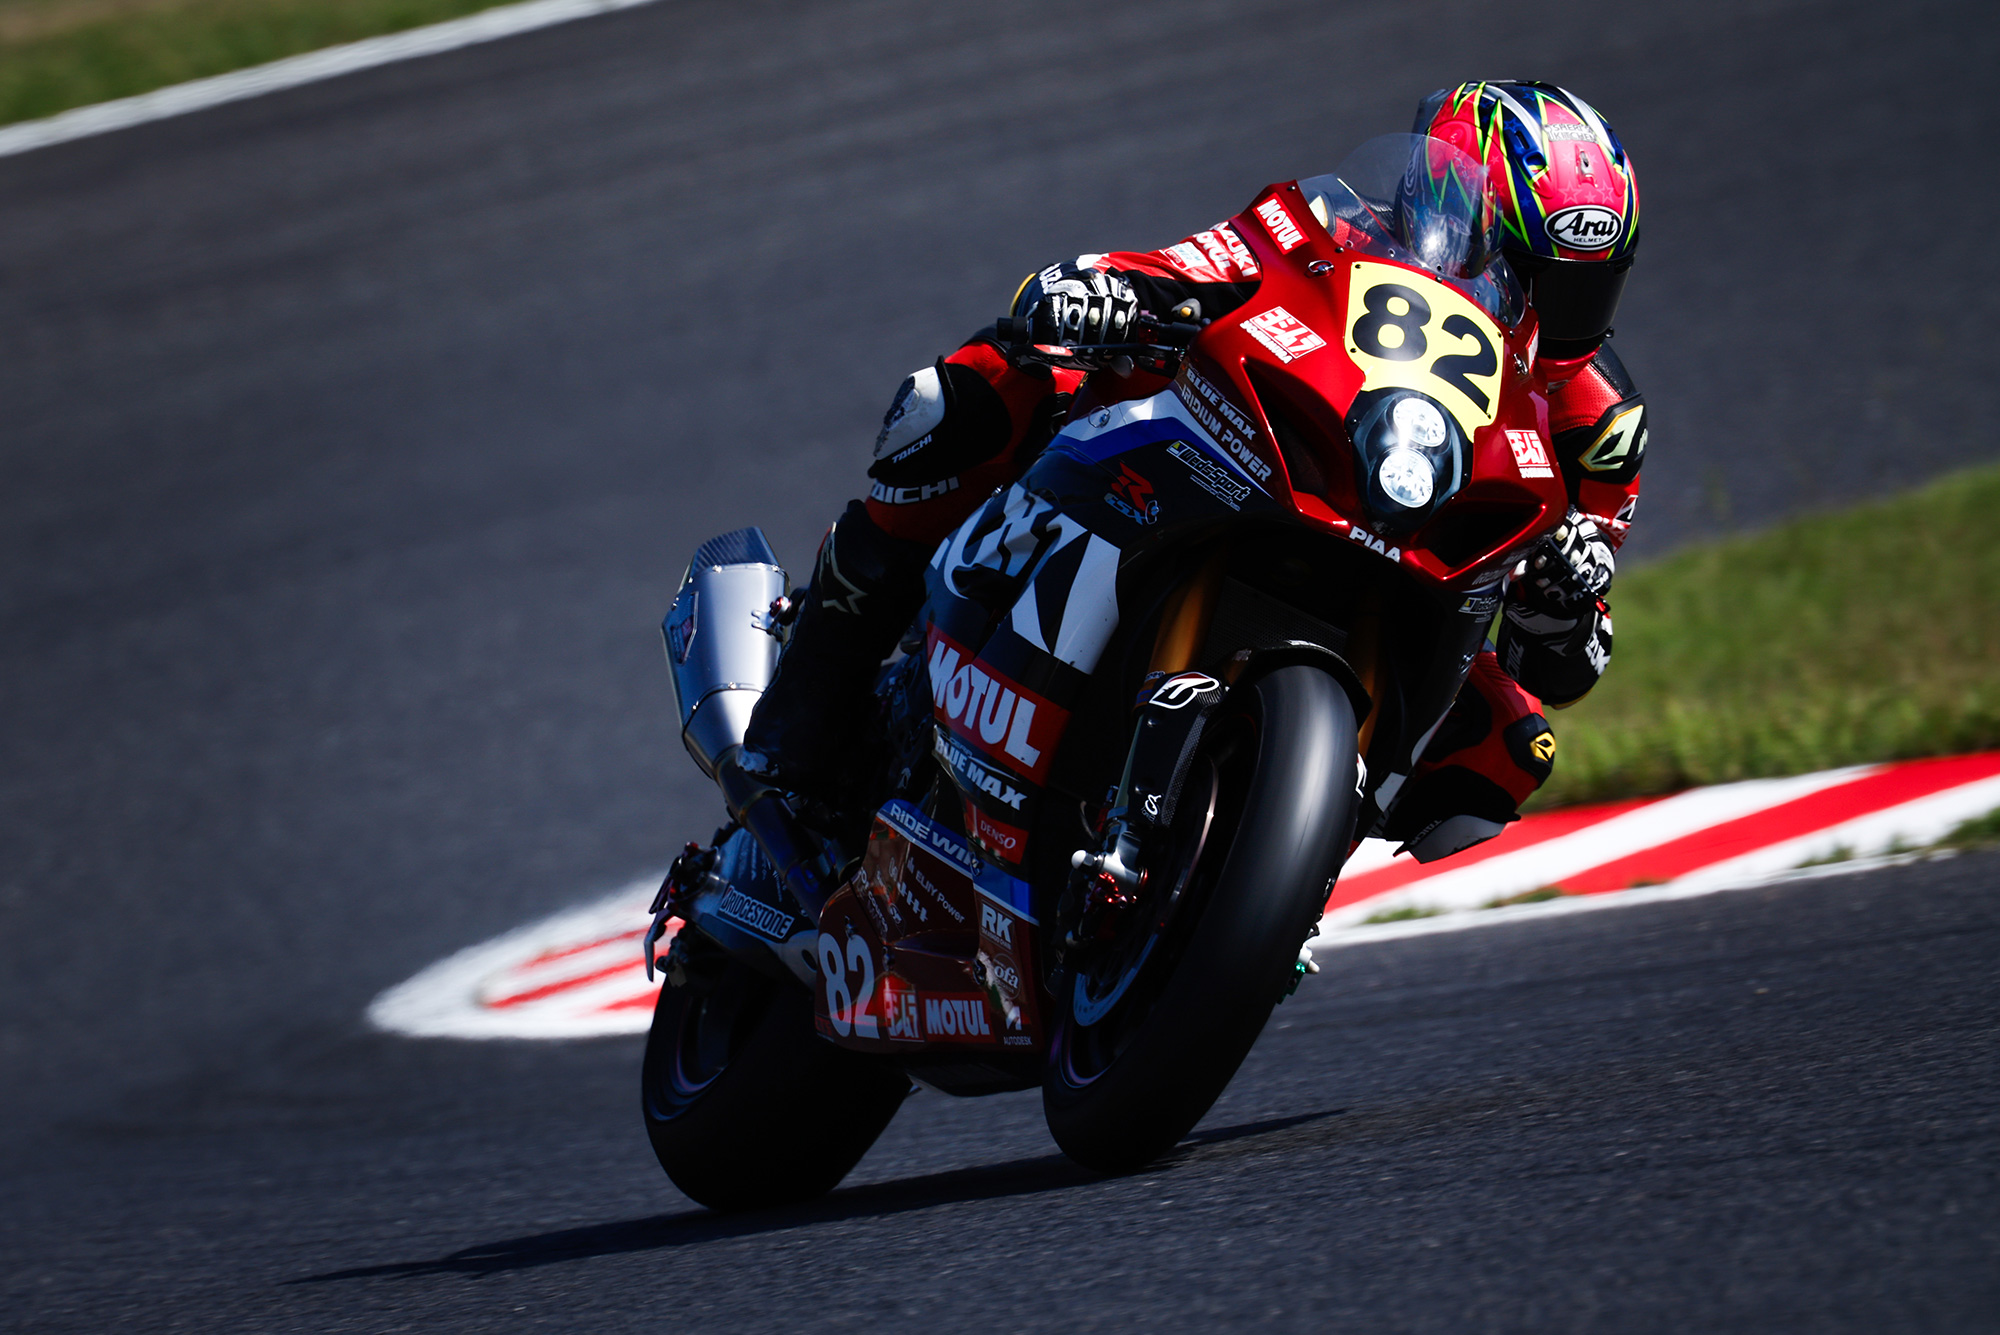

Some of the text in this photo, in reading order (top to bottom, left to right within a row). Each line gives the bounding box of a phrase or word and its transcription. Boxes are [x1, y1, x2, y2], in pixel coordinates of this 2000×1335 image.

[1256, 198, 1303, 251] MOTUL
[1552, 212, 1616, 236] Arai
[1192, 231, 1231, 273] OTUL
[1352, 283, 1498, 414] 82
[1186, 367, 1221, 407] BLUE
[1218, 401, 1257, 441] MAX
[891, 433, 934, 464] TAICHI
[1221, 428, 1273, 483] POWER
[870, 476, 960, 504] AICHI
[1349, 525, 1401, 564] PIAA
[928, 639, 1042, 768] MOTUL
[966, 761, 1029, 813] MAX
[980, 819, 1016, 849] DENSO
[720, 885, 795, 938] BRIDGESTONE
[981, 903, 1014, 944] RK
[818, 932, 880, 1041] 82
[924, 998, 992, 1037] MOTUL
